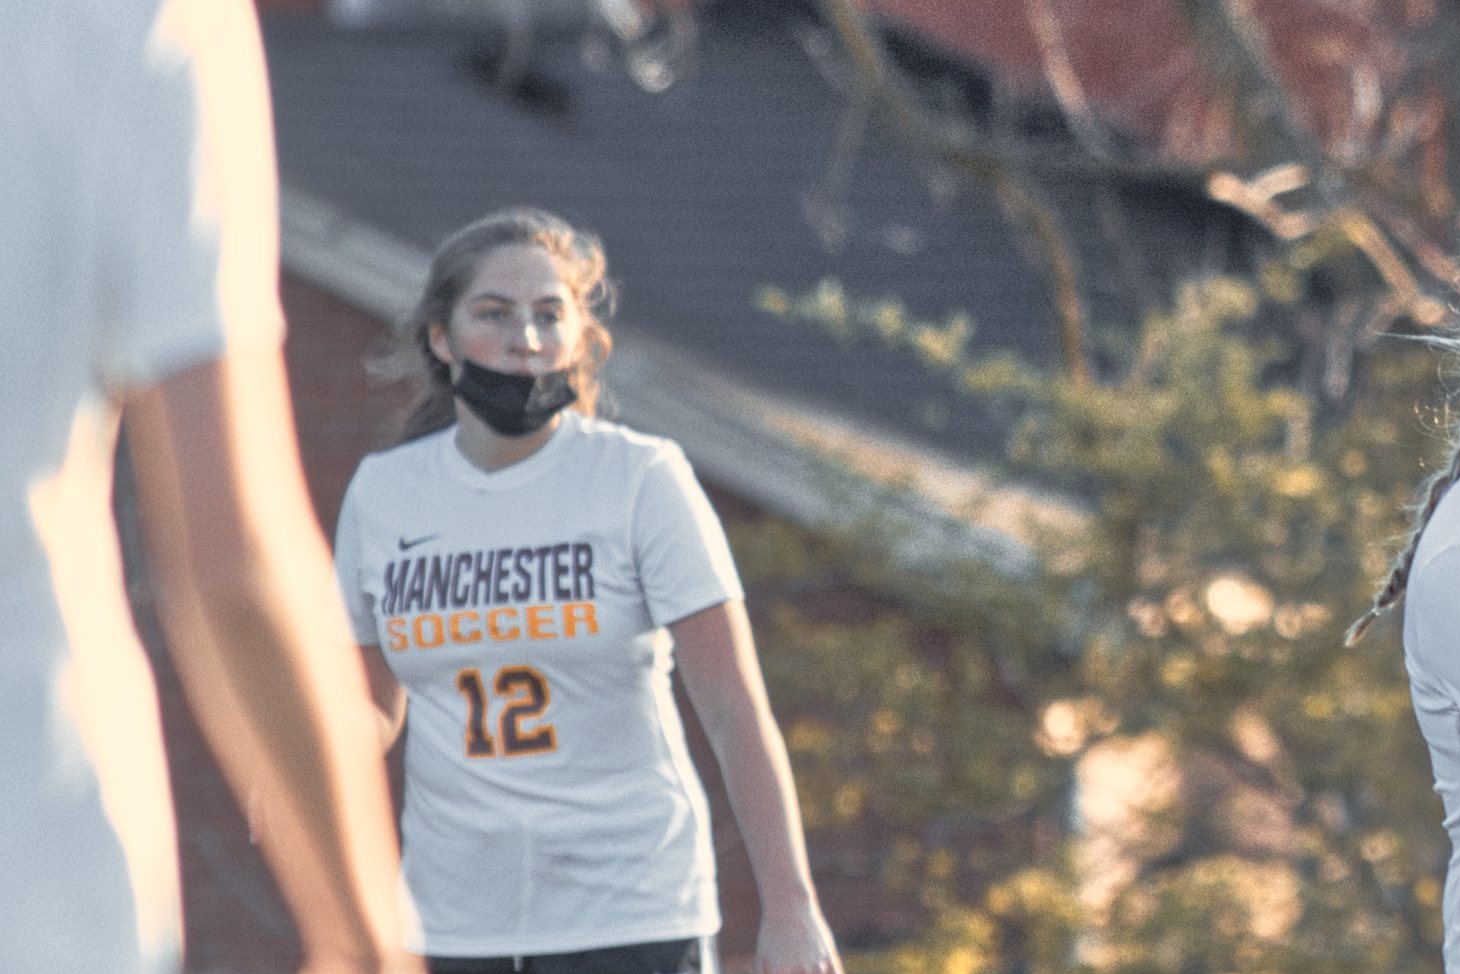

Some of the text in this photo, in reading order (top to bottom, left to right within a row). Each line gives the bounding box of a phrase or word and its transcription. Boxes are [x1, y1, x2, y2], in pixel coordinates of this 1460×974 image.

[382, 542, 595, 615] MANCHESTER
[385, 602, 599, 652] SOCCER
[456, 664, 557, 758] 12
